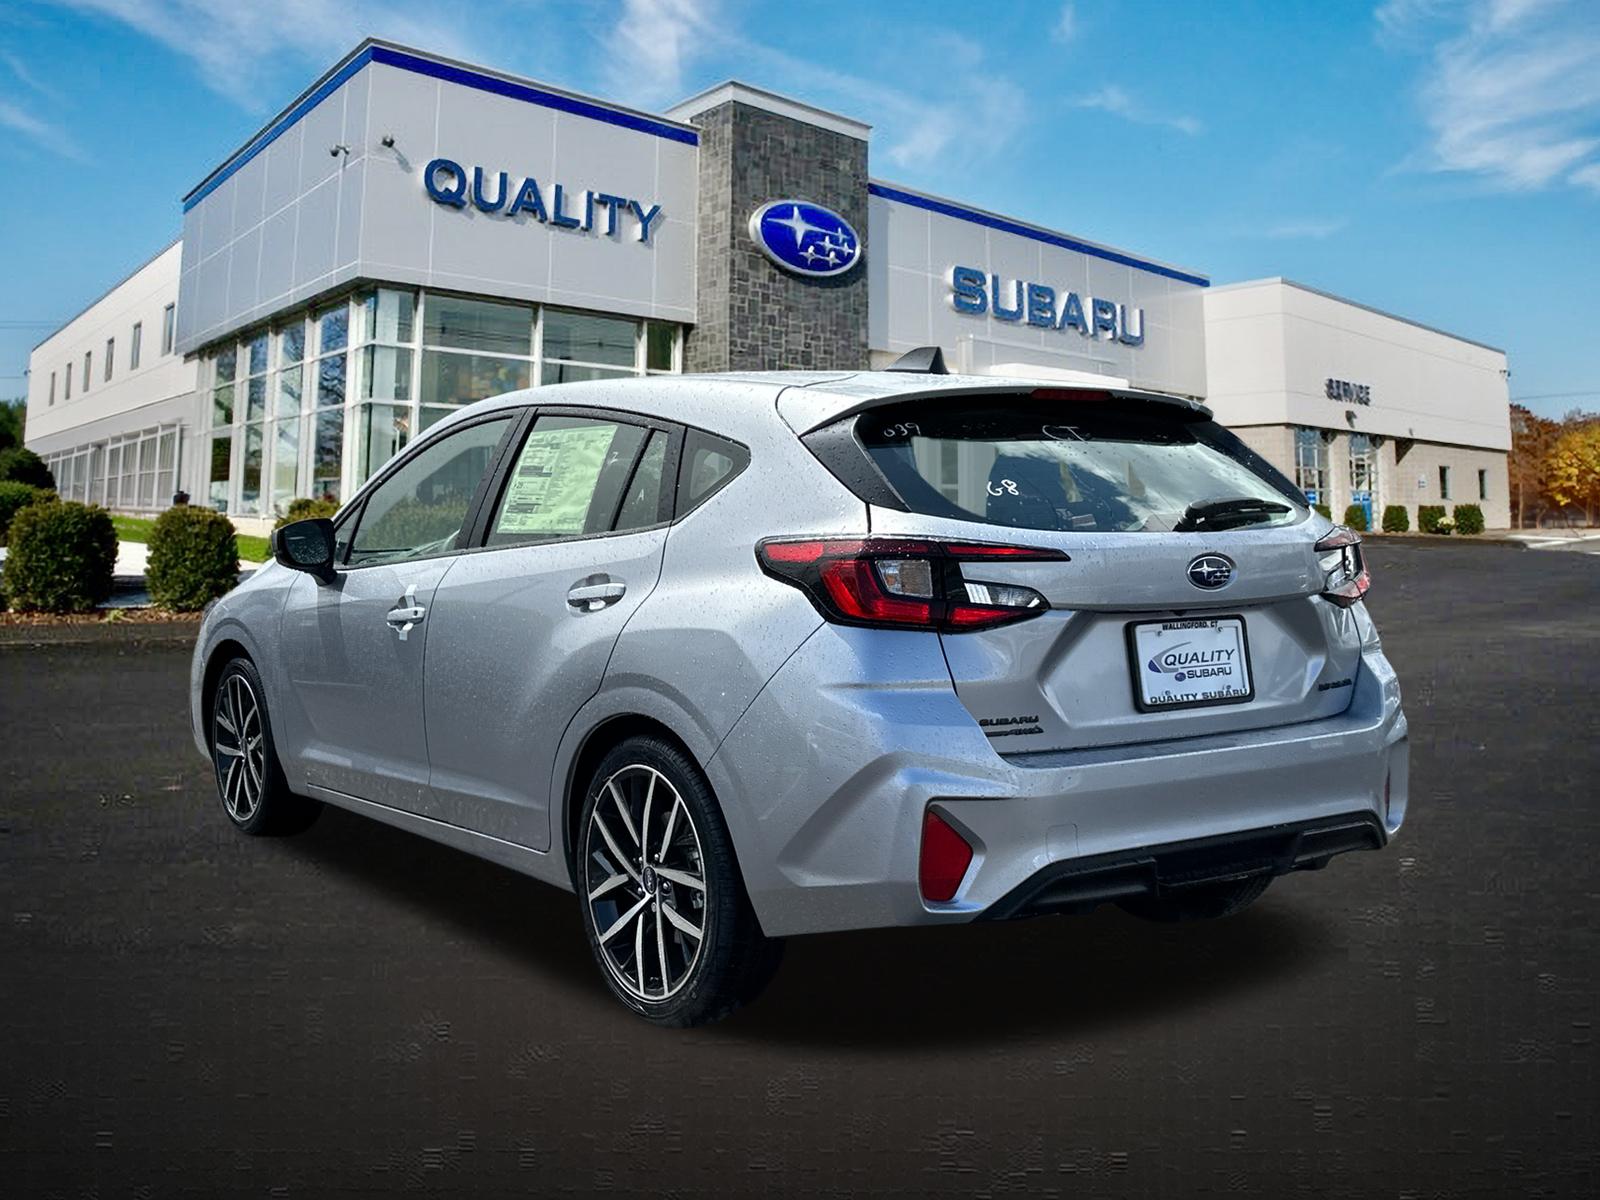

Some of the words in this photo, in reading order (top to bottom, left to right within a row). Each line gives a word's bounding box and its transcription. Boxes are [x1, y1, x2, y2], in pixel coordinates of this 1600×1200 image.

[423, 158, 662, 242] QUALITY
[951, 265, 1145, 346] SUBARU
[1164, 648, 1235, 666] QUALITY
[1187, 666, 1232, 679] SUBARU
[1150, 692, 1198, 704] QUALITY
[1202, 688, 1248, 700] SUBARU
[979, 715, 1039, 726] SUBARU
